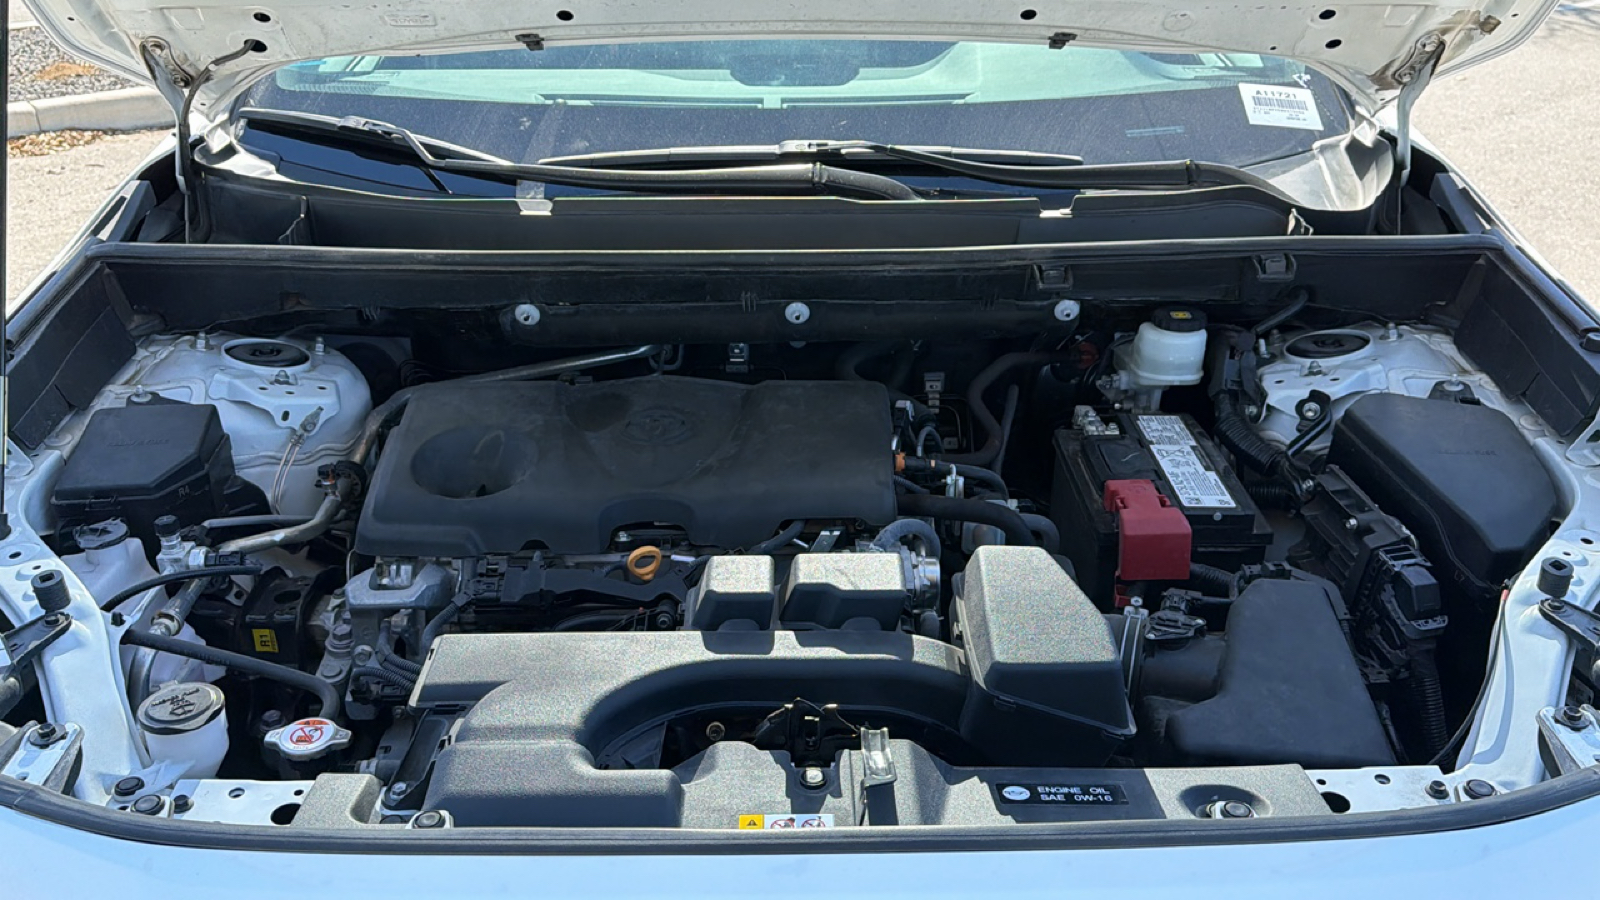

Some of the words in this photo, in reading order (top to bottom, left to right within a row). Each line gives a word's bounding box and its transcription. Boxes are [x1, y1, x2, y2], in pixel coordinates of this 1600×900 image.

[1255, 90, 1297, 99] A11721
[259, 634, 270, 647] R1
[1037, 786, 1082, 794] ENGINE
[1089, 786, 1111, 795] OIL
